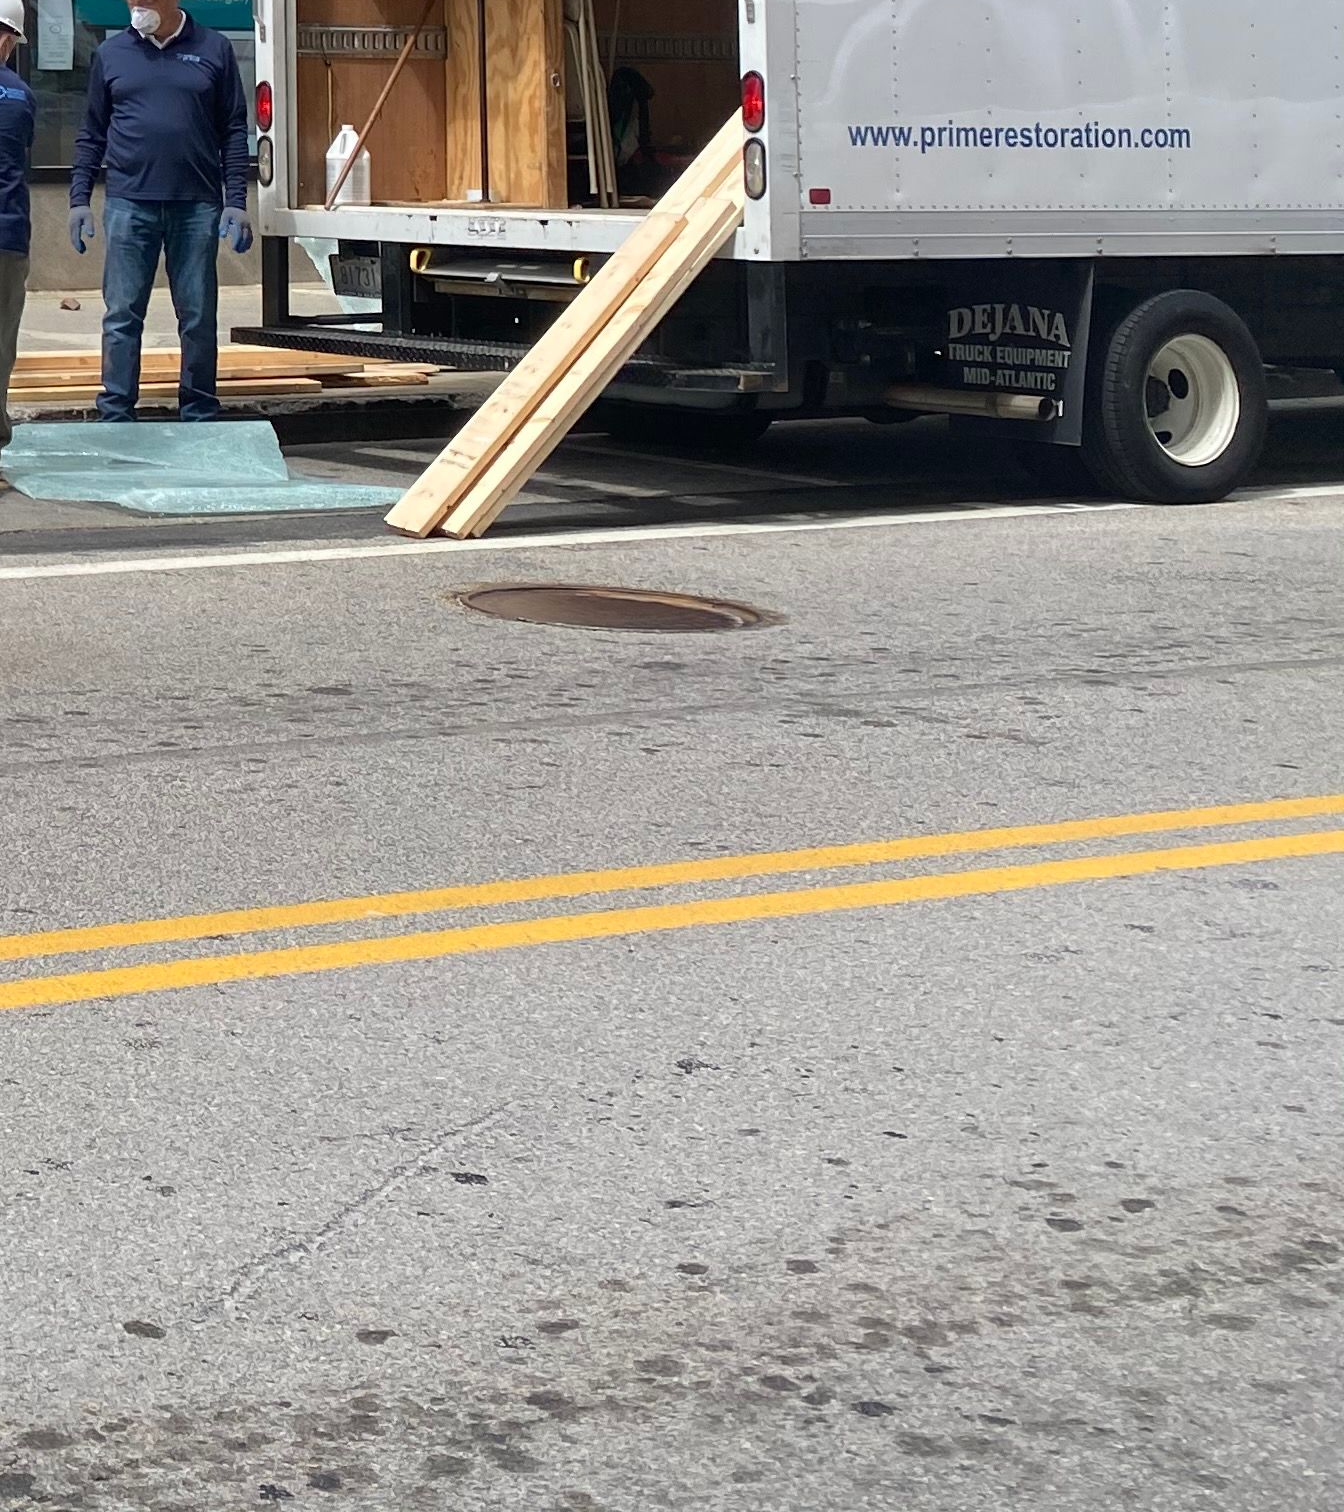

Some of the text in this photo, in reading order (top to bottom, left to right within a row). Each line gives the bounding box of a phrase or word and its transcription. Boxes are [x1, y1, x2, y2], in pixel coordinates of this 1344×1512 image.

[847, 120, 1191, 154] www.primerestoration.com
[947, 303, 1071, 348] DEJANA
[948, 343, 1072, 369] TRUCK EQUIPMENT
[963, 367, 1057, 391] MID-ATLANTIC
